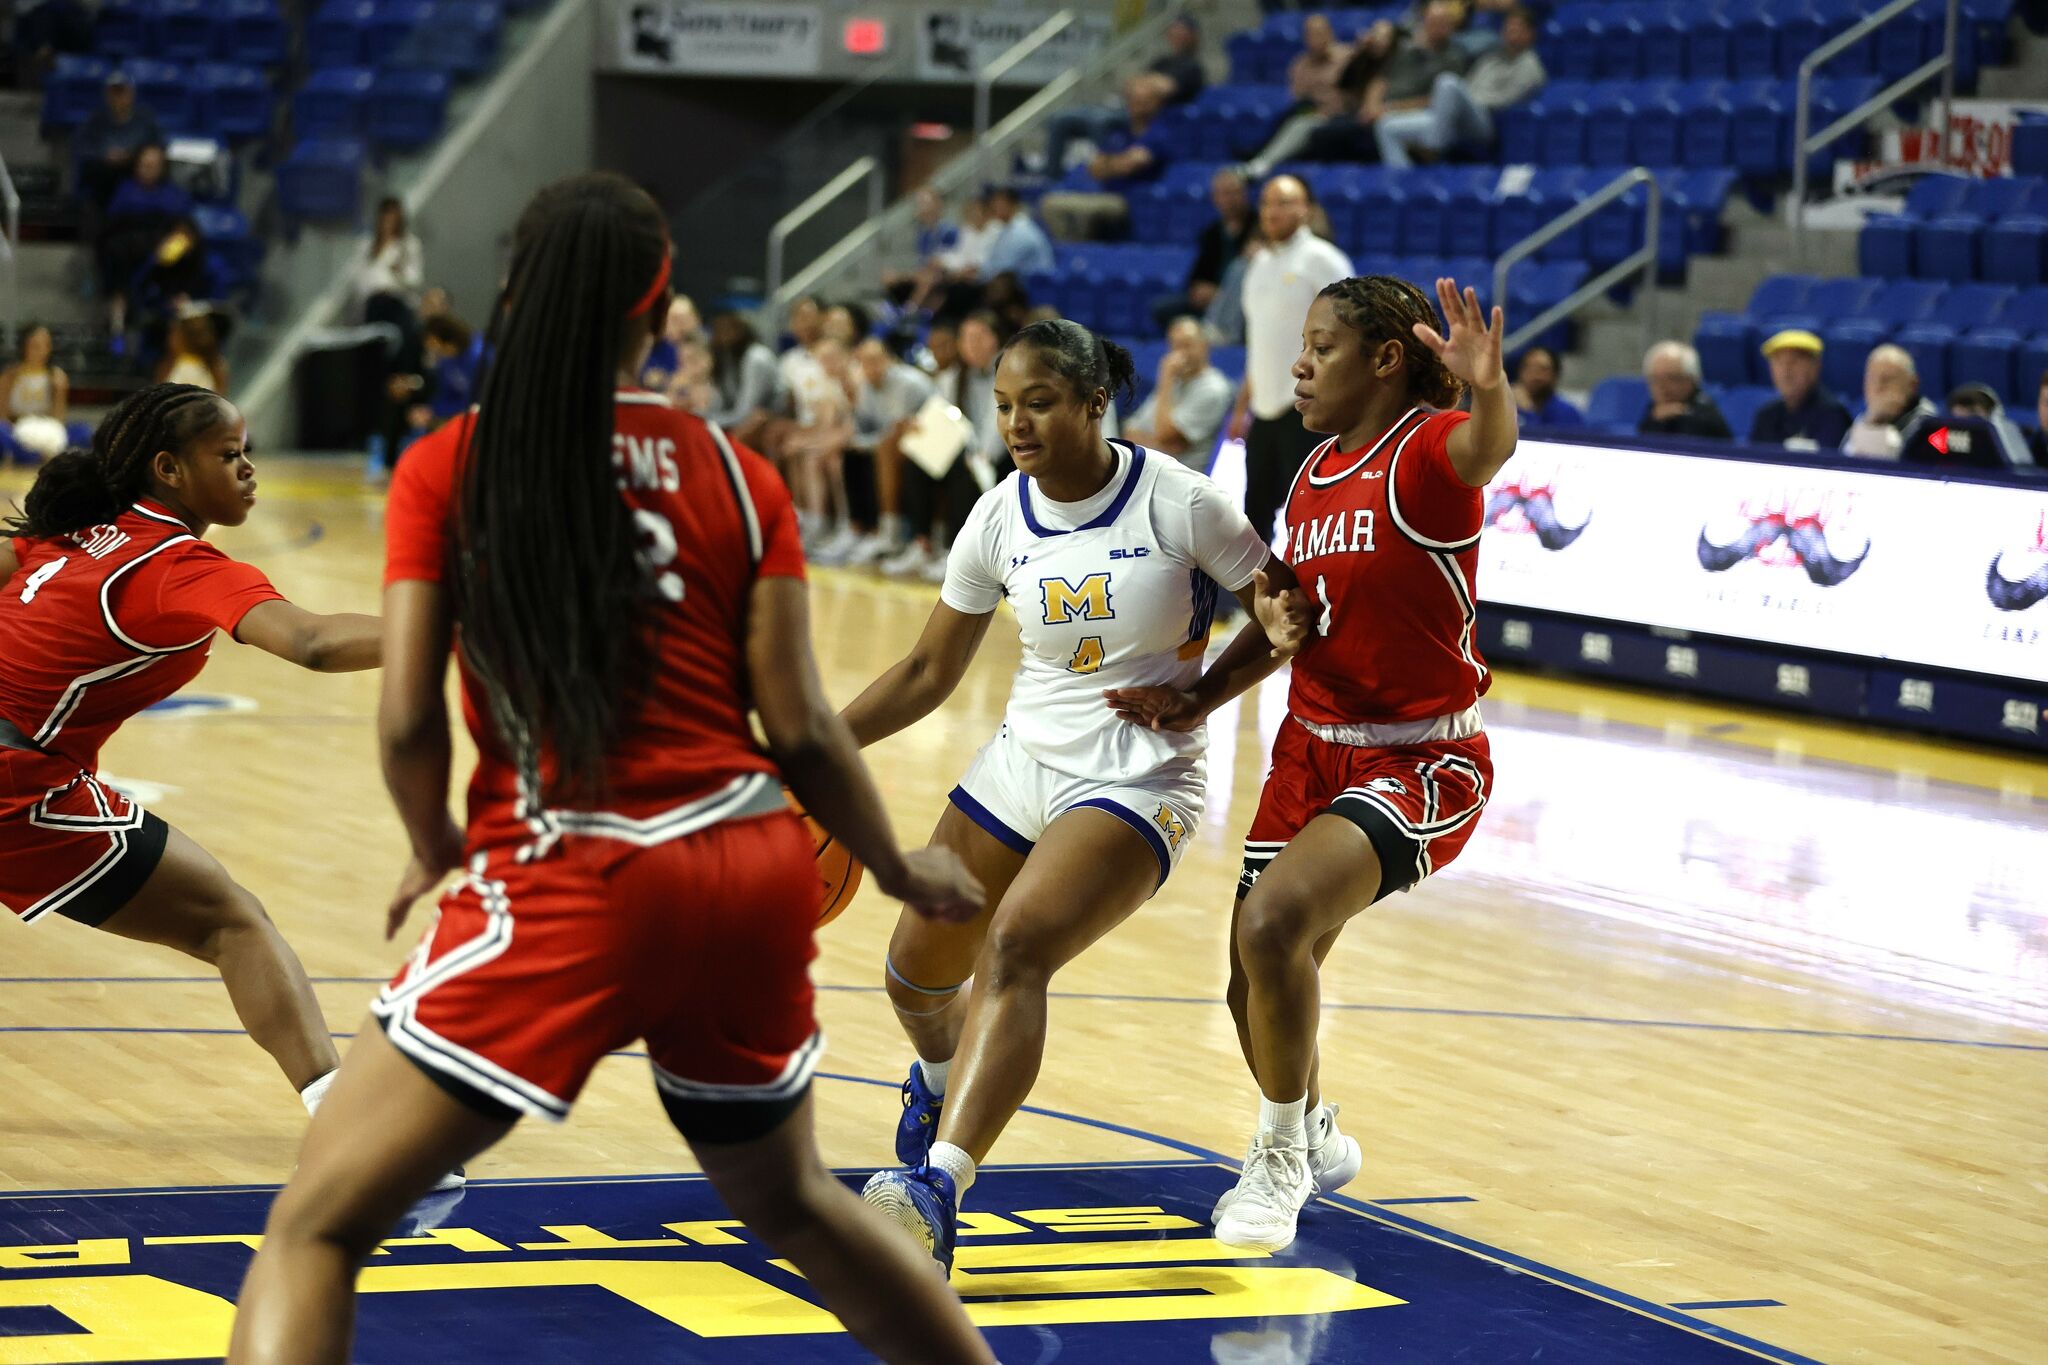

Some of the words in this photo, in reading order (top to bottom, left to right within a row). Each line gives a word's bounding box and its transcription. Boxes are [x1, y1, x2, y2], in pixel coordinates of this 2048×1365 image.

[1109, 547, 1151, 560] SLC
[20, 556, 69, 604] 4
[1039, 572, 1115, 625] M
[1316, 574, 1332, 637] 1
[1066, 636, 1105, 673] 4
